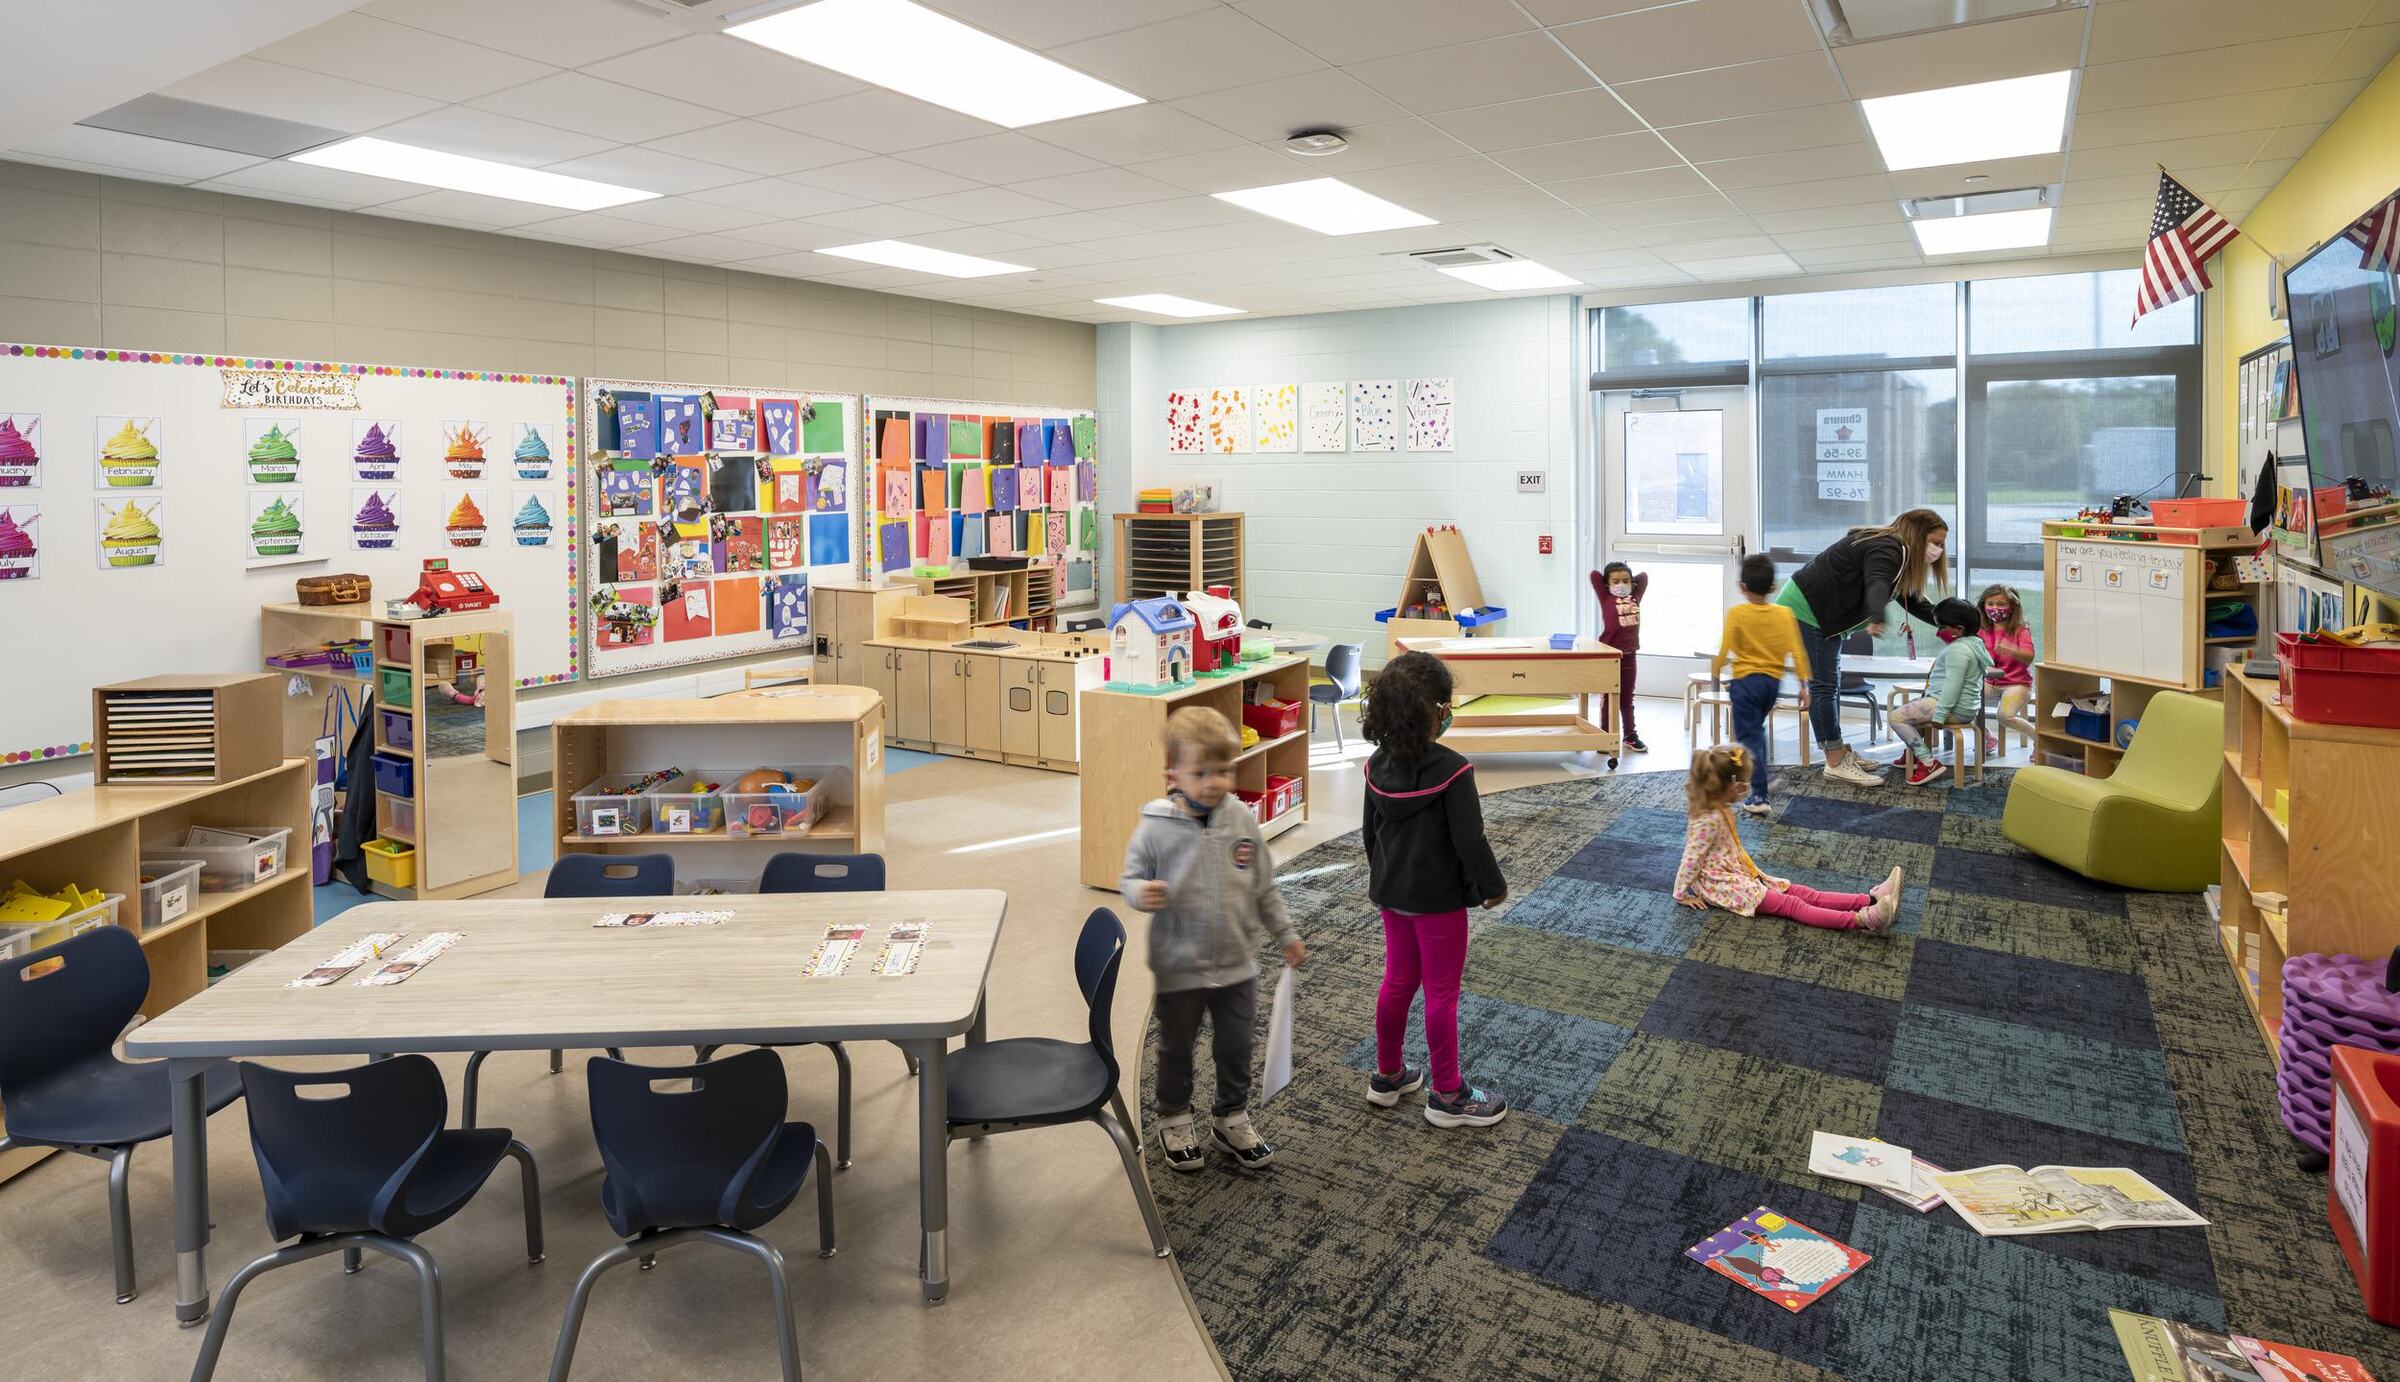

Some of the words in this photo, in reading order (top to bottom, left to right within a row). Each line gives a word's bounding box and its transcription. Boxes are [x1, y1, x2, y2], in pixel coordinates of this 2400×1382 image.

[239, 379, 270, 396] Let's
[275, 380, 346, 396] Celebrate
[265, 395, 323, 404] BIRTHDAYS
[1309, 405, 1334, 418] Green
[107, 467, 153, 476] February
[369, 463, 386, 471] April
[1520, 475, 1541, 484] EXIT
[255, 537, 299, 545] September
[114, 547, 149, 556] August
[2060, 544, 2077, 555] How
[2080, 547, 2094, 555] are
[2097, 548, 2112, 560] you
[2114, 546, 2146, 568] feeling
[2136, 1318, 2174, 1374] KNUFFLE
